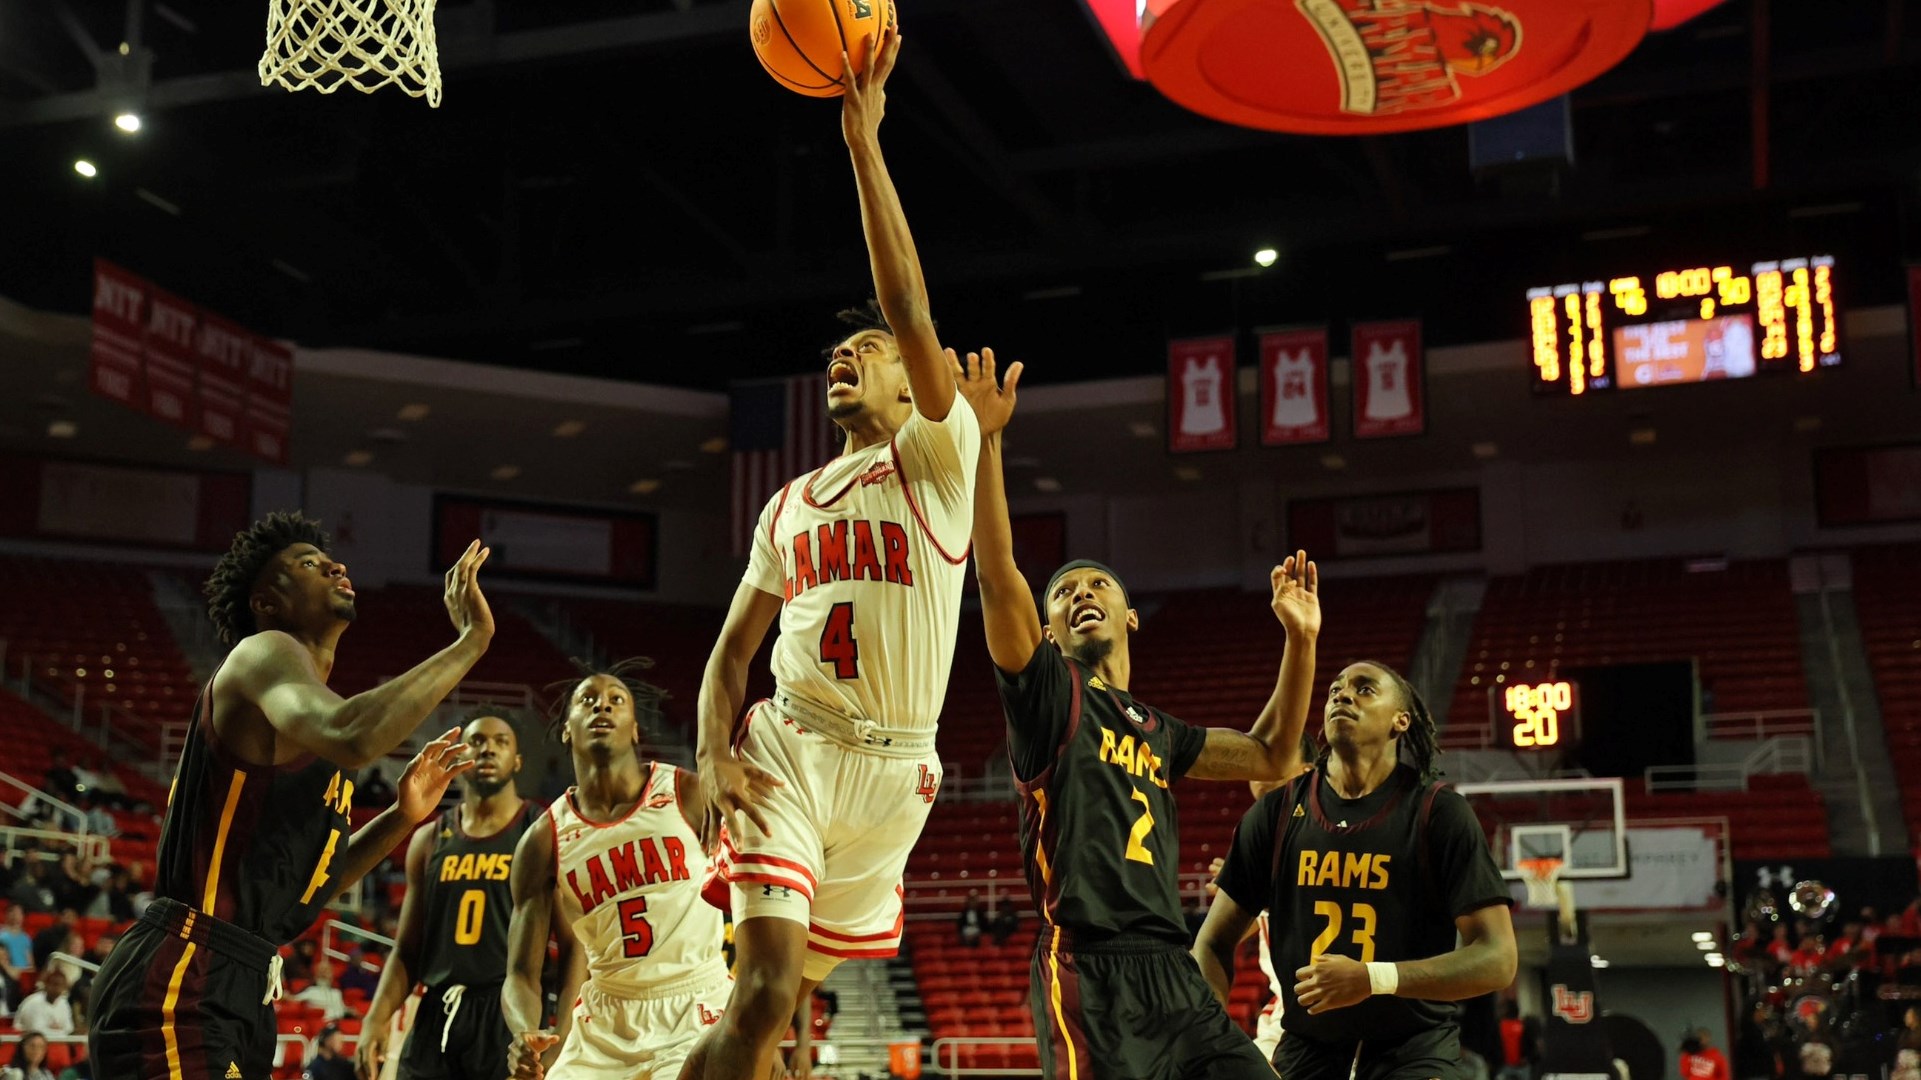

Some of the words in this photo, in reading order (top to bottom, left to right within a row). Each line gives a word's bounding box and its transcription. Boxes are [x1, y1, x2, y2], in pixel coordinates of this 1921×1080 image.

[820, 601, 859, 680] 4
[1505, 682, 1571, 712] 18:00
[1513, 708, 1558, 747] 20
[1125, 785, 1155, 866] 2
[440, 852, 514, 883] RAMS
[566, 836, 690, 914] LAMAR
[1297, 849, 1391, 890] RAMS
[454, 888, 487, 945] 0
[617, 895, 654, 958] 5
[1310, 900, 1377, 967] 23
